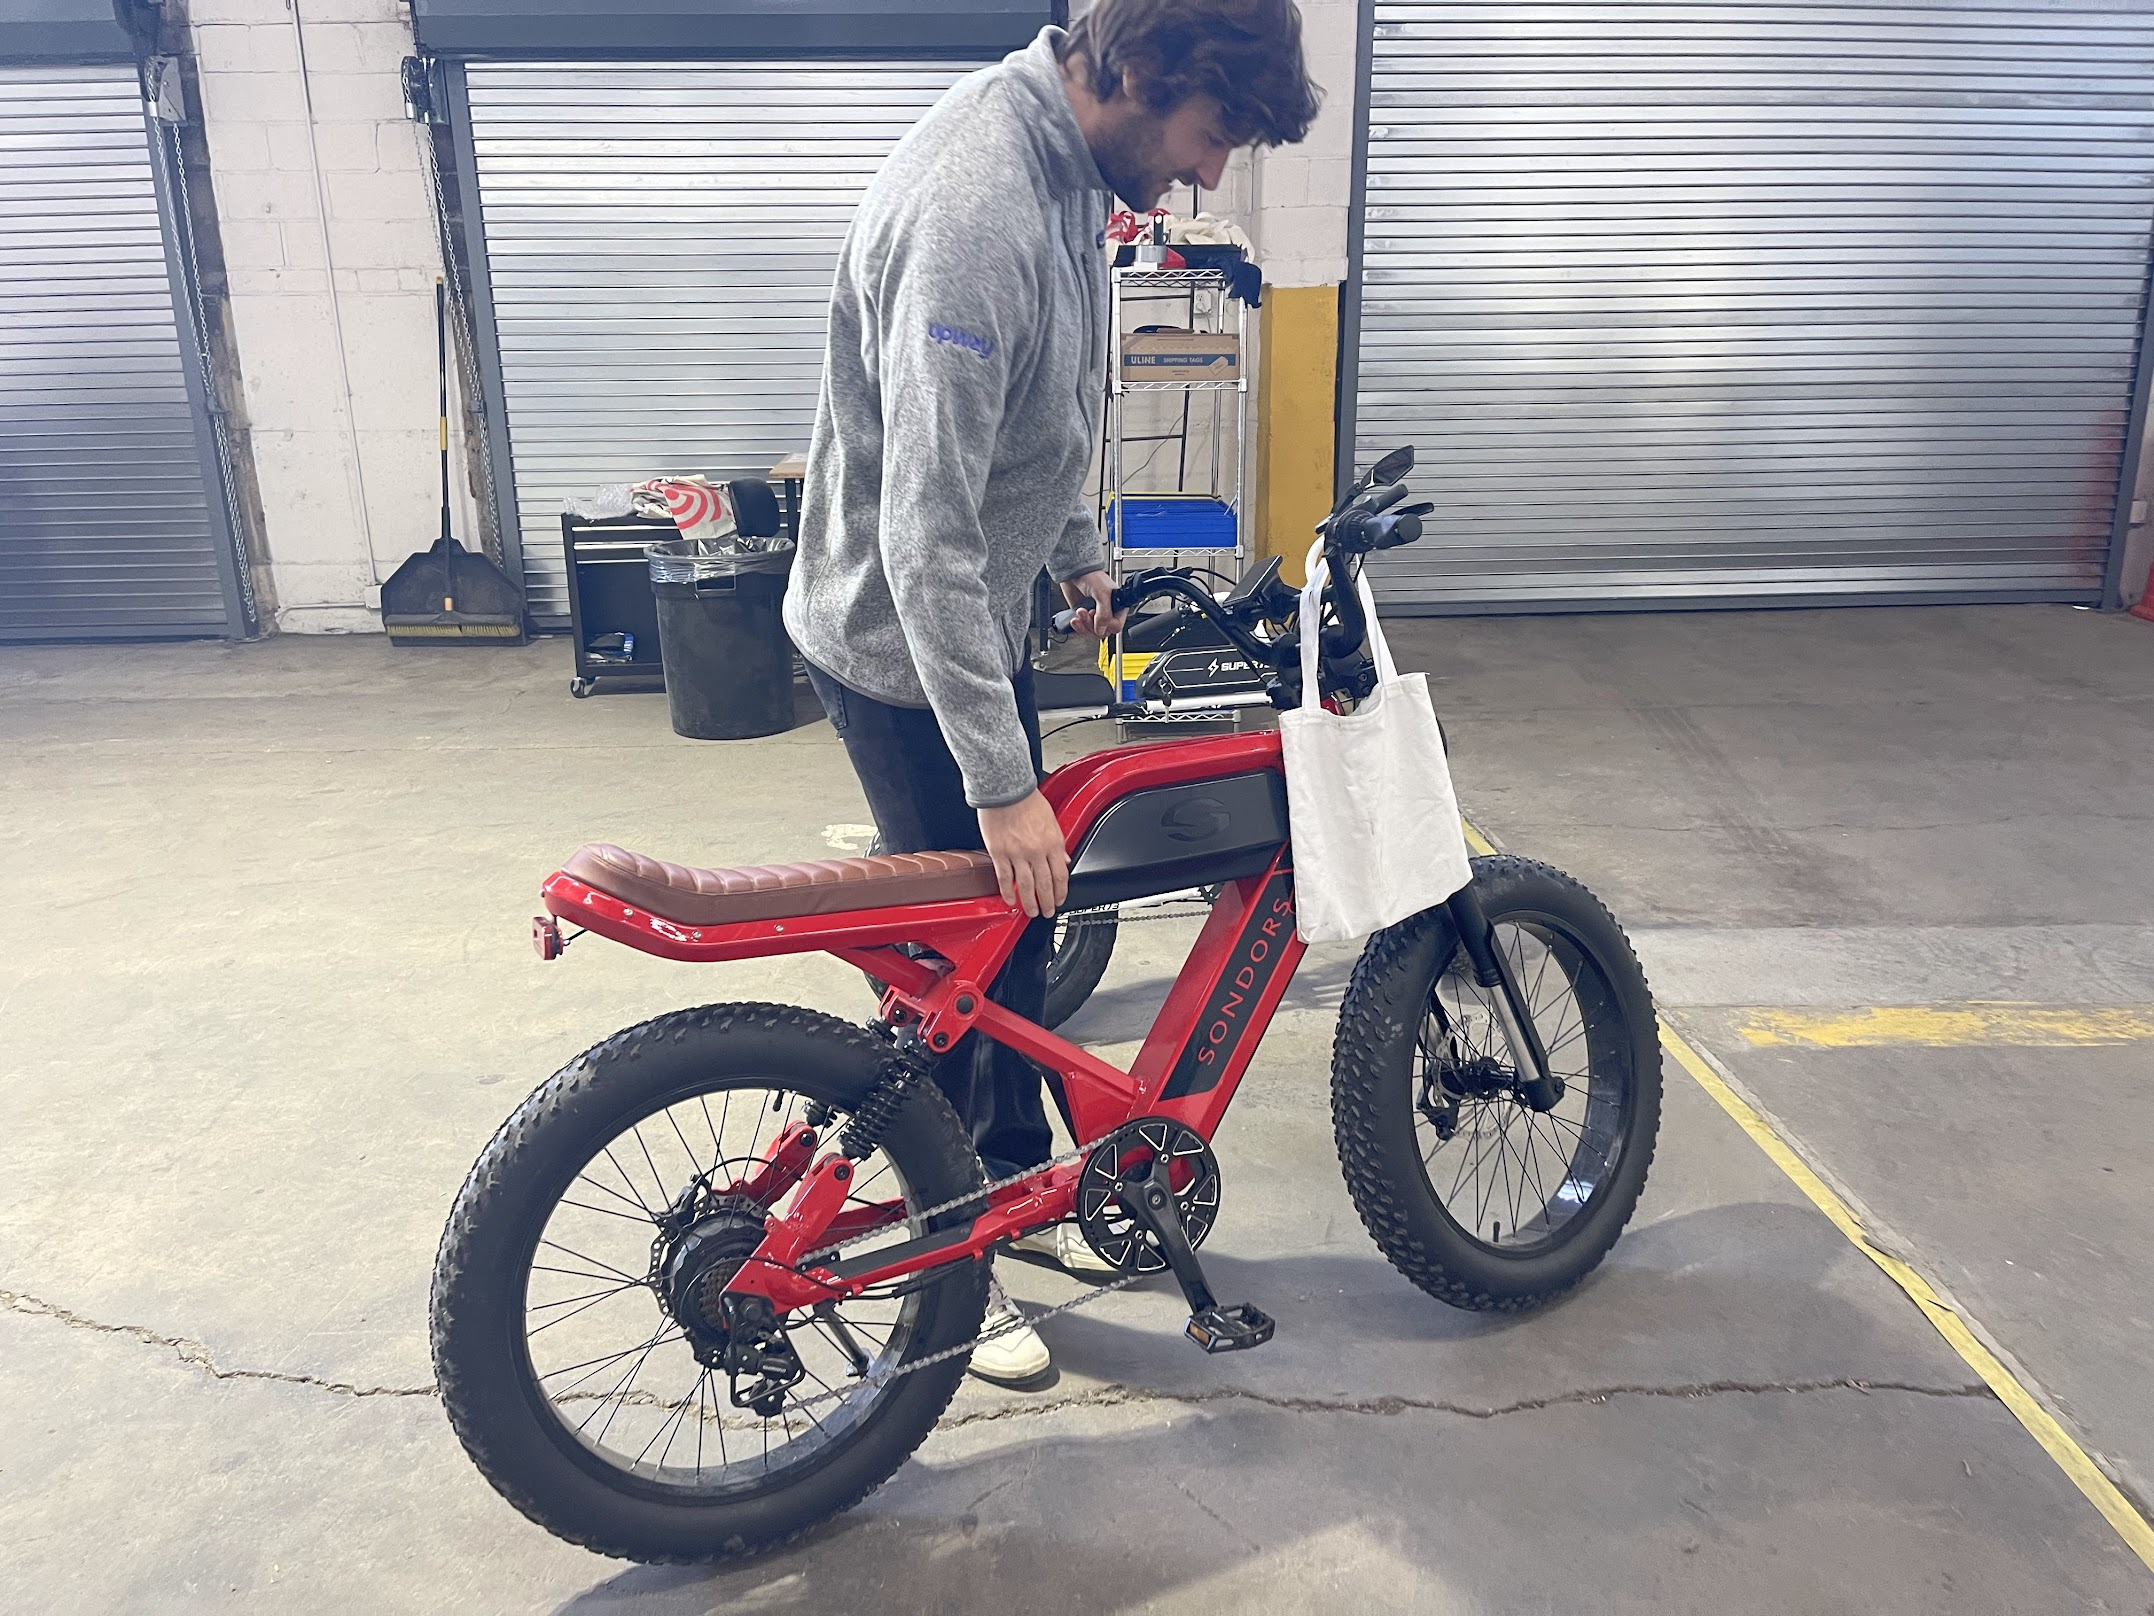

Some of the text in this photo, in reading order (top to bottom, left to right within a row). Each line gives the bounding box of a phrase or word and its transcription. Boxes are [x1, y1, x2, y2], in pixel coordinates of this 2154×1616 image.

[1130, 355, 1156, 364] ULINE
[1189, 356, 1203, 364] TAGS
[1197, 897, 1290, 1065] SONDORS
